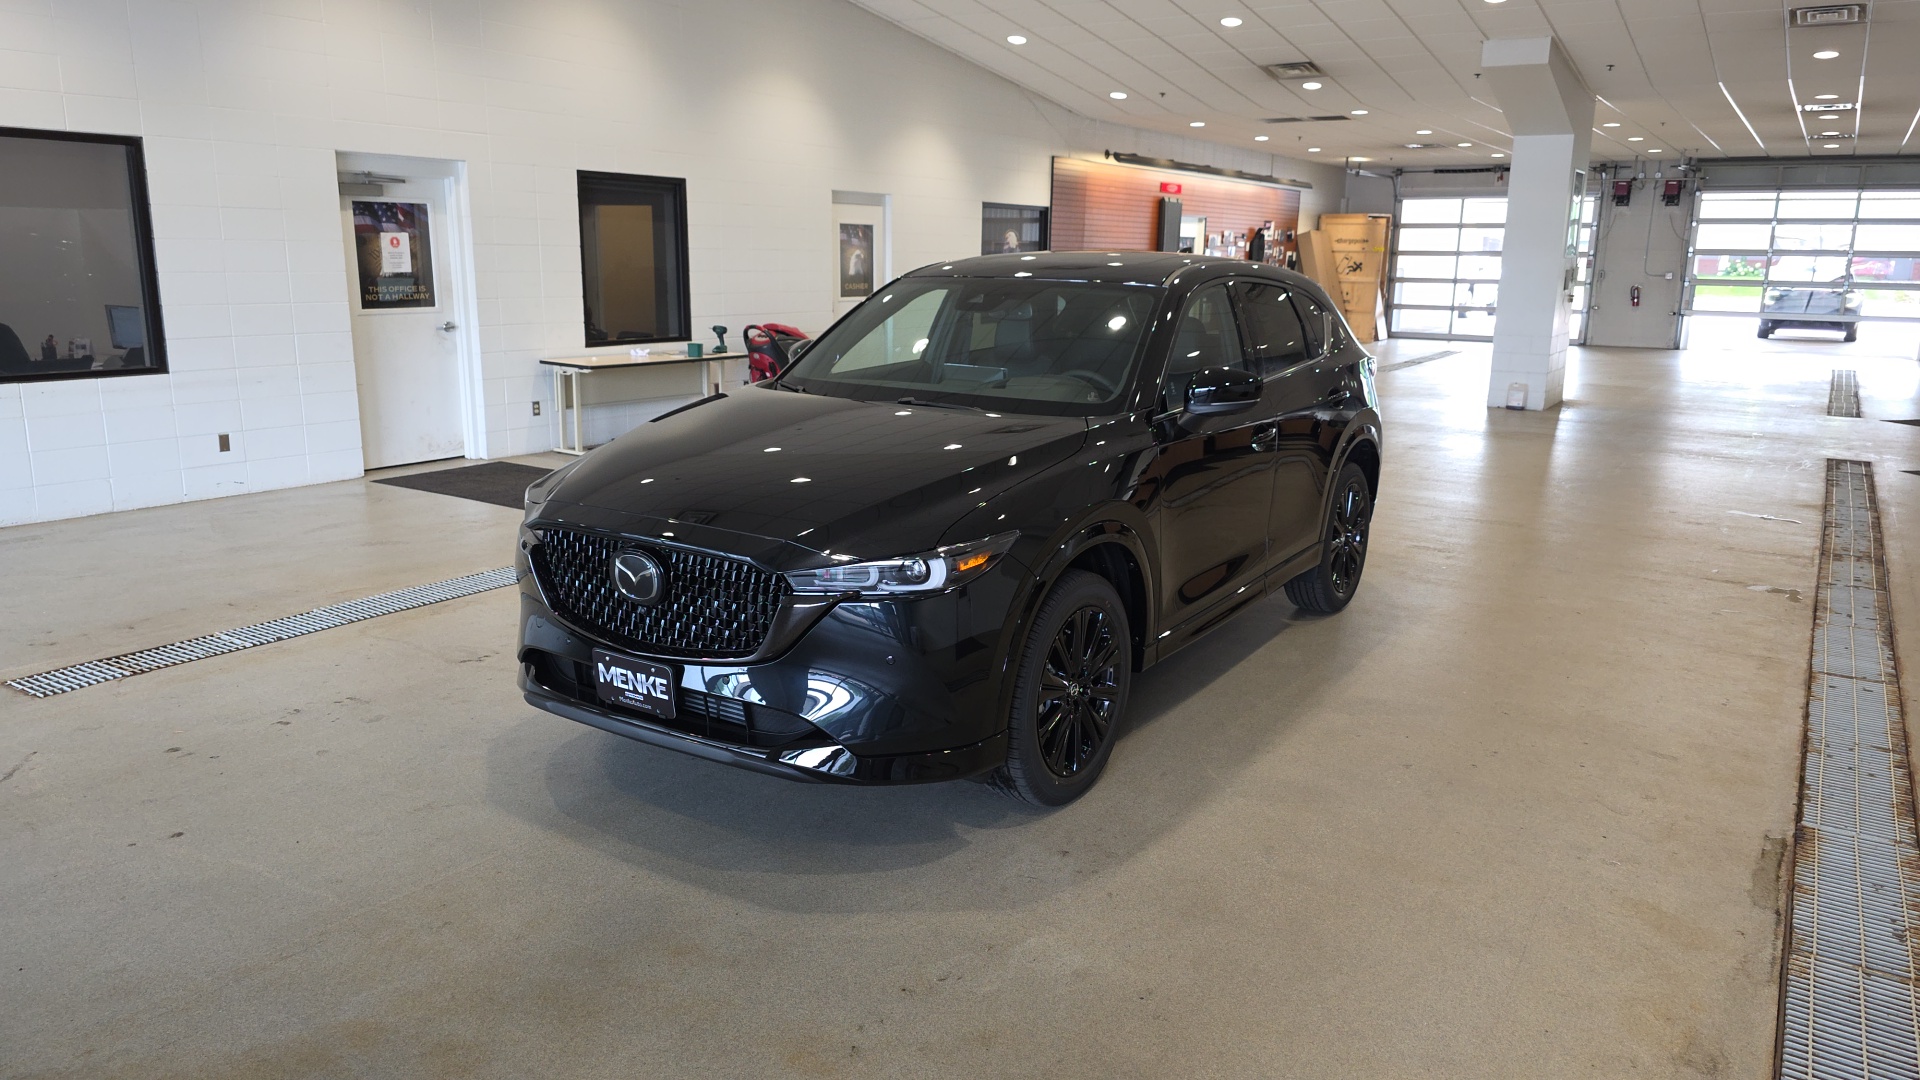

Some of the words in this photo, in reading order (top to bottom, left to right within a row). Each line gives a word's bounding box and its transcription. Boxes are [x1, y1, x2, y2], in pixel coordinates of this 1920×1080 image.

[388, 285, 417, 293] OFFICE
[844, 282, 869, 290] CASHIER
[597, 662, 669, 700] MENKE
